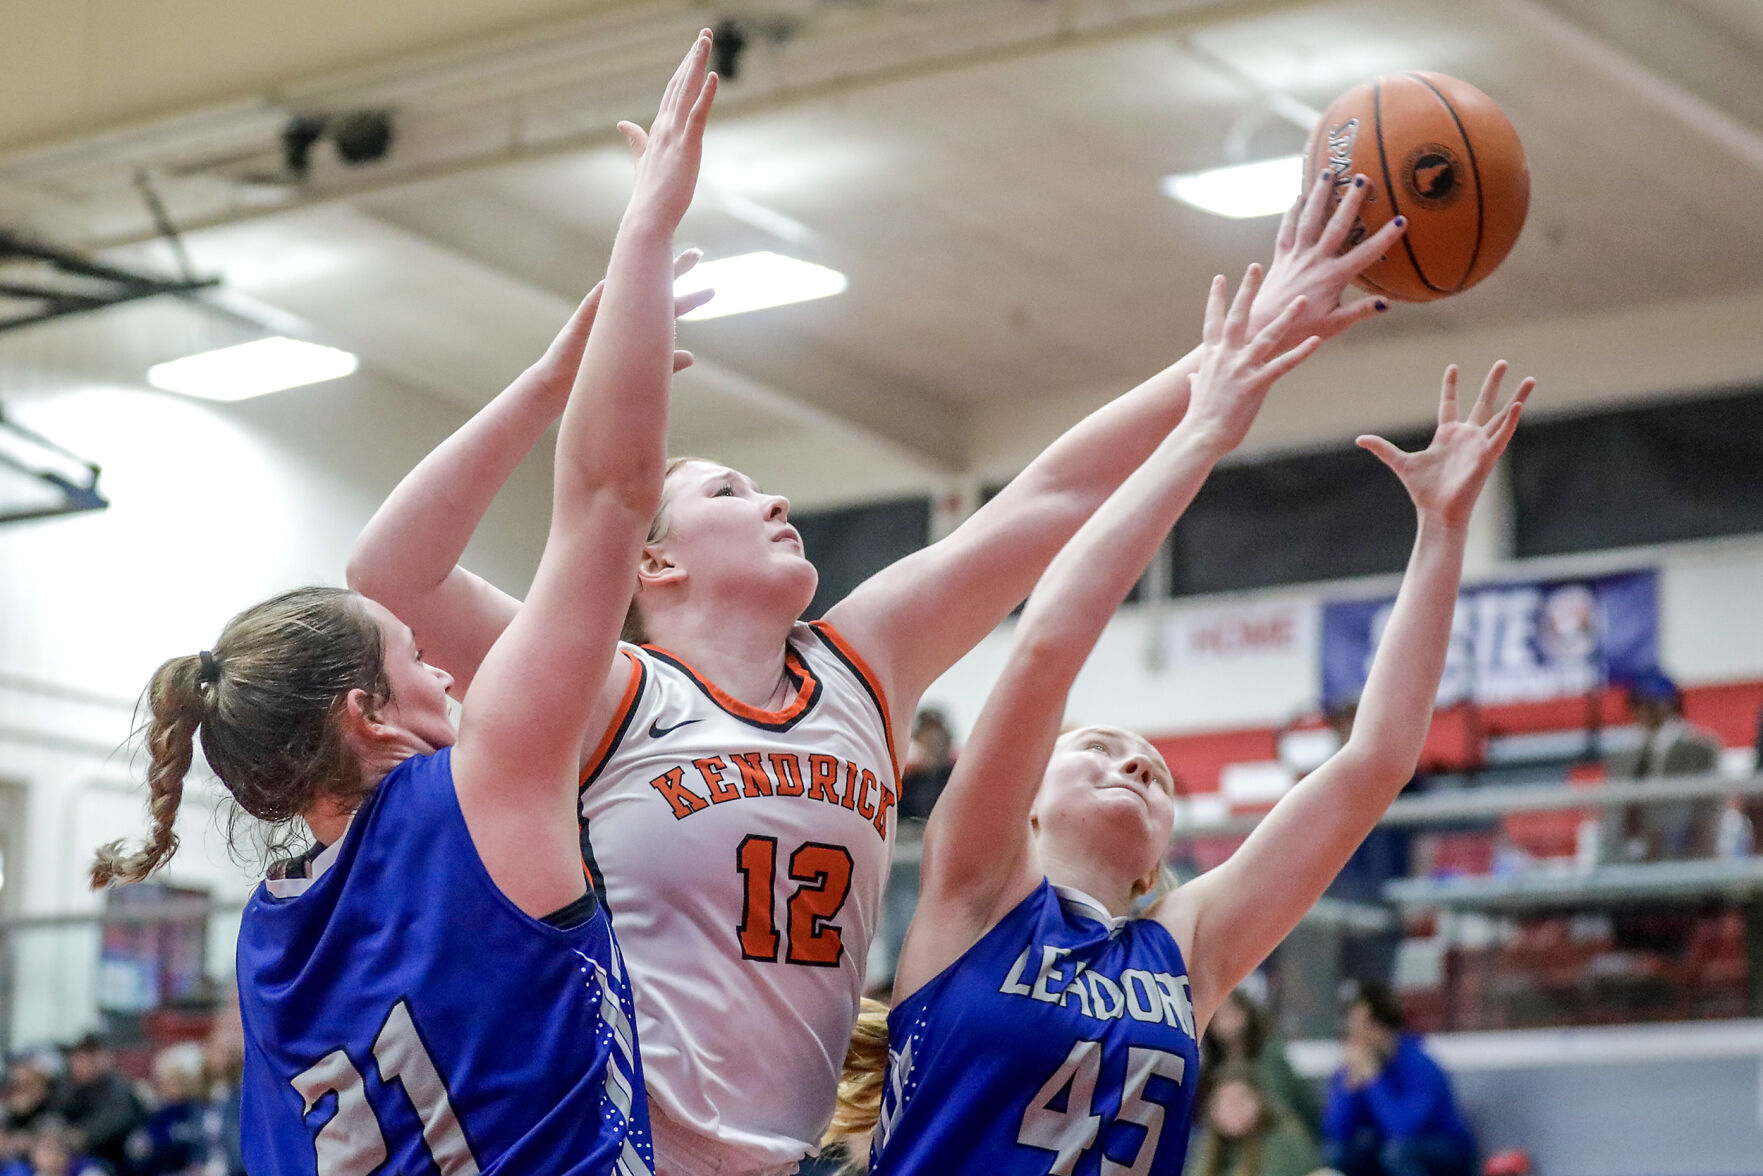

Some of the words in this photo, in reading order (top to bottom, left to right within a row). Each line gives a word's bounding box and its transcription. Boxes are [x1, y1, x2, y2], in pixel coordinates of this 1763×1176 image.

[650, 753, 895, 842] KENDRICK
[736, 834, 854, 967] 12
[290, 1000, 484, 1175] 21
[1017, 1041, 1185, 1175] 45
